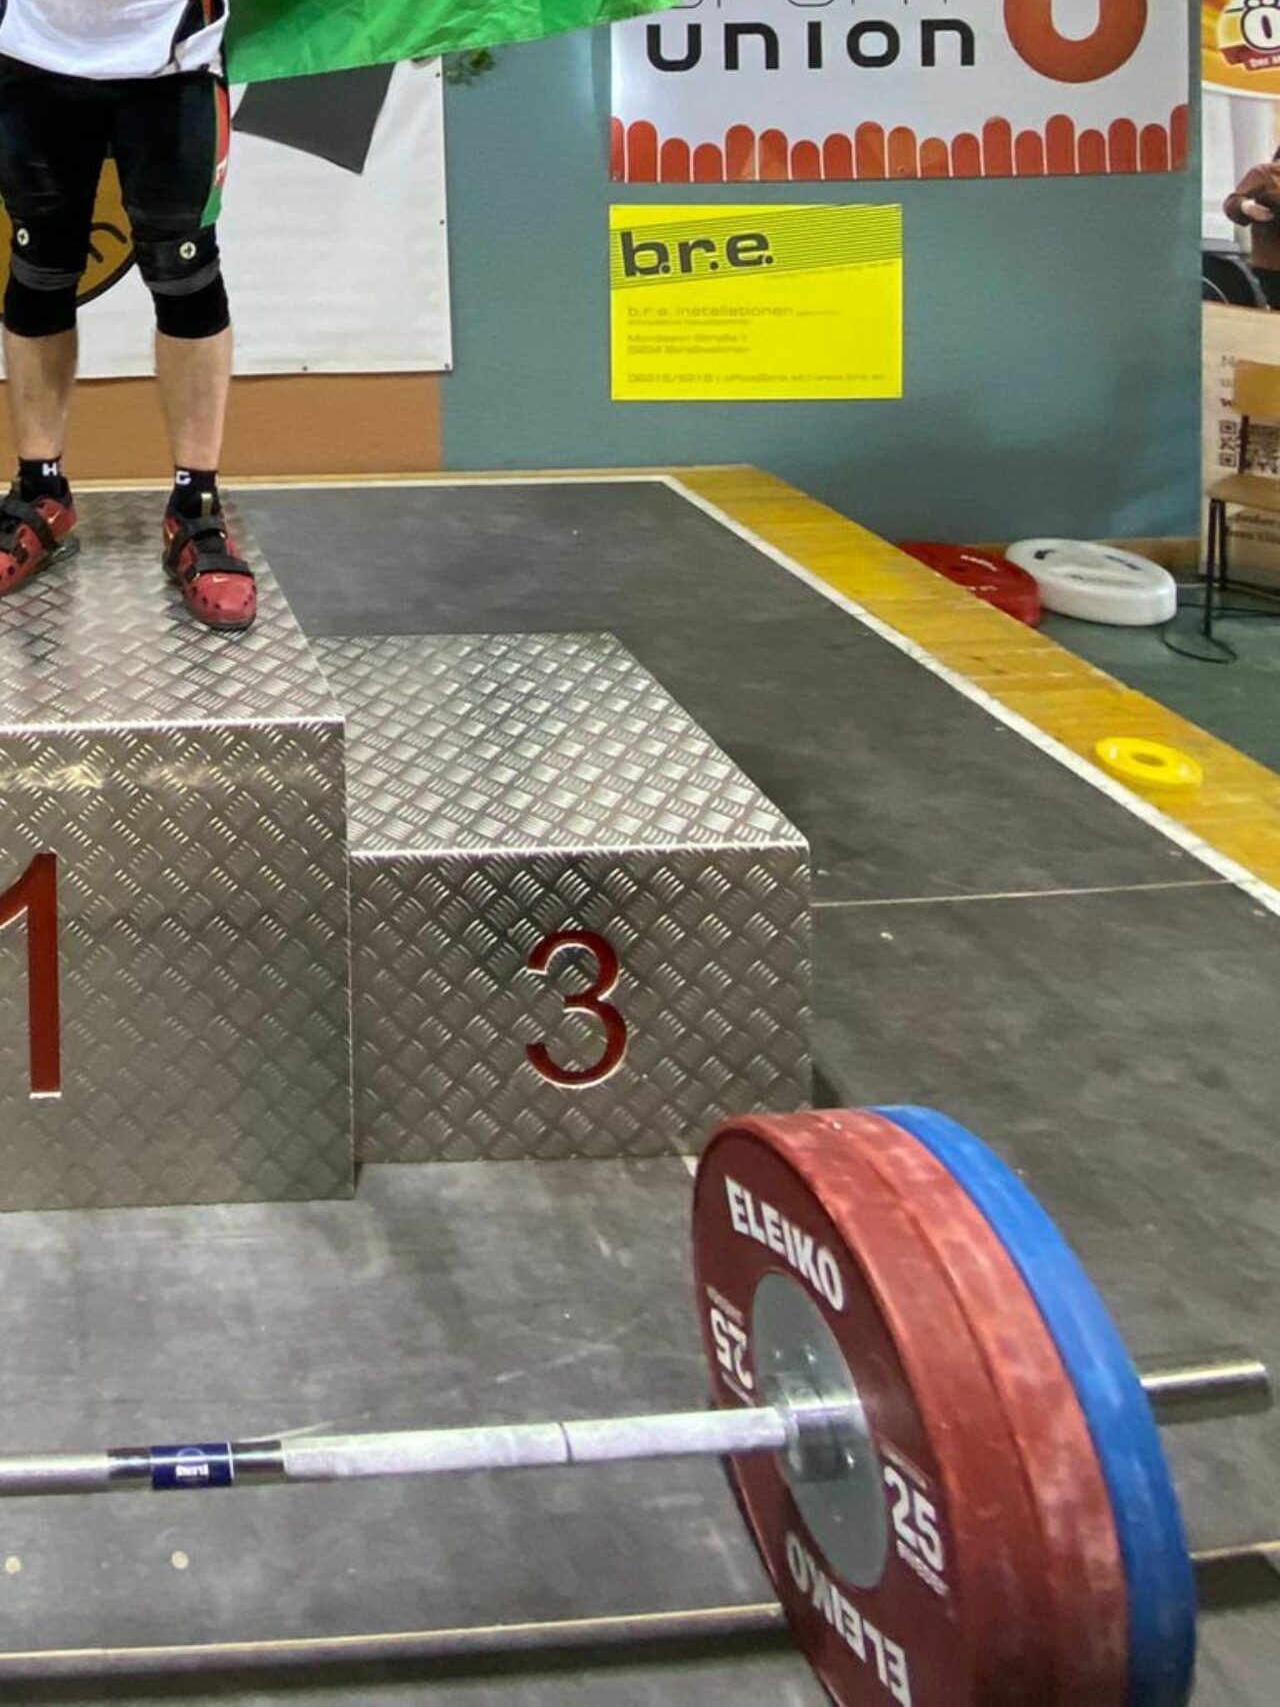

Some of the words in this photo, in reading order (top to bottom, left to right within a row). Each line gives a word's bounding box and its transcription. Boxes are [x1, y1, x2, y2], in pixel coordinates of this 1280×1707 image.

[646, 18, 975, 72] union
[620, 230, 774, 278] b.r.e.
[525, 928, 628, 1089] 3
[725, 1175, 844, 1312] ELEIKO
[883, 1464, 944, 1573] 25
[786, 1531, 913, 1707] ELEIKO
